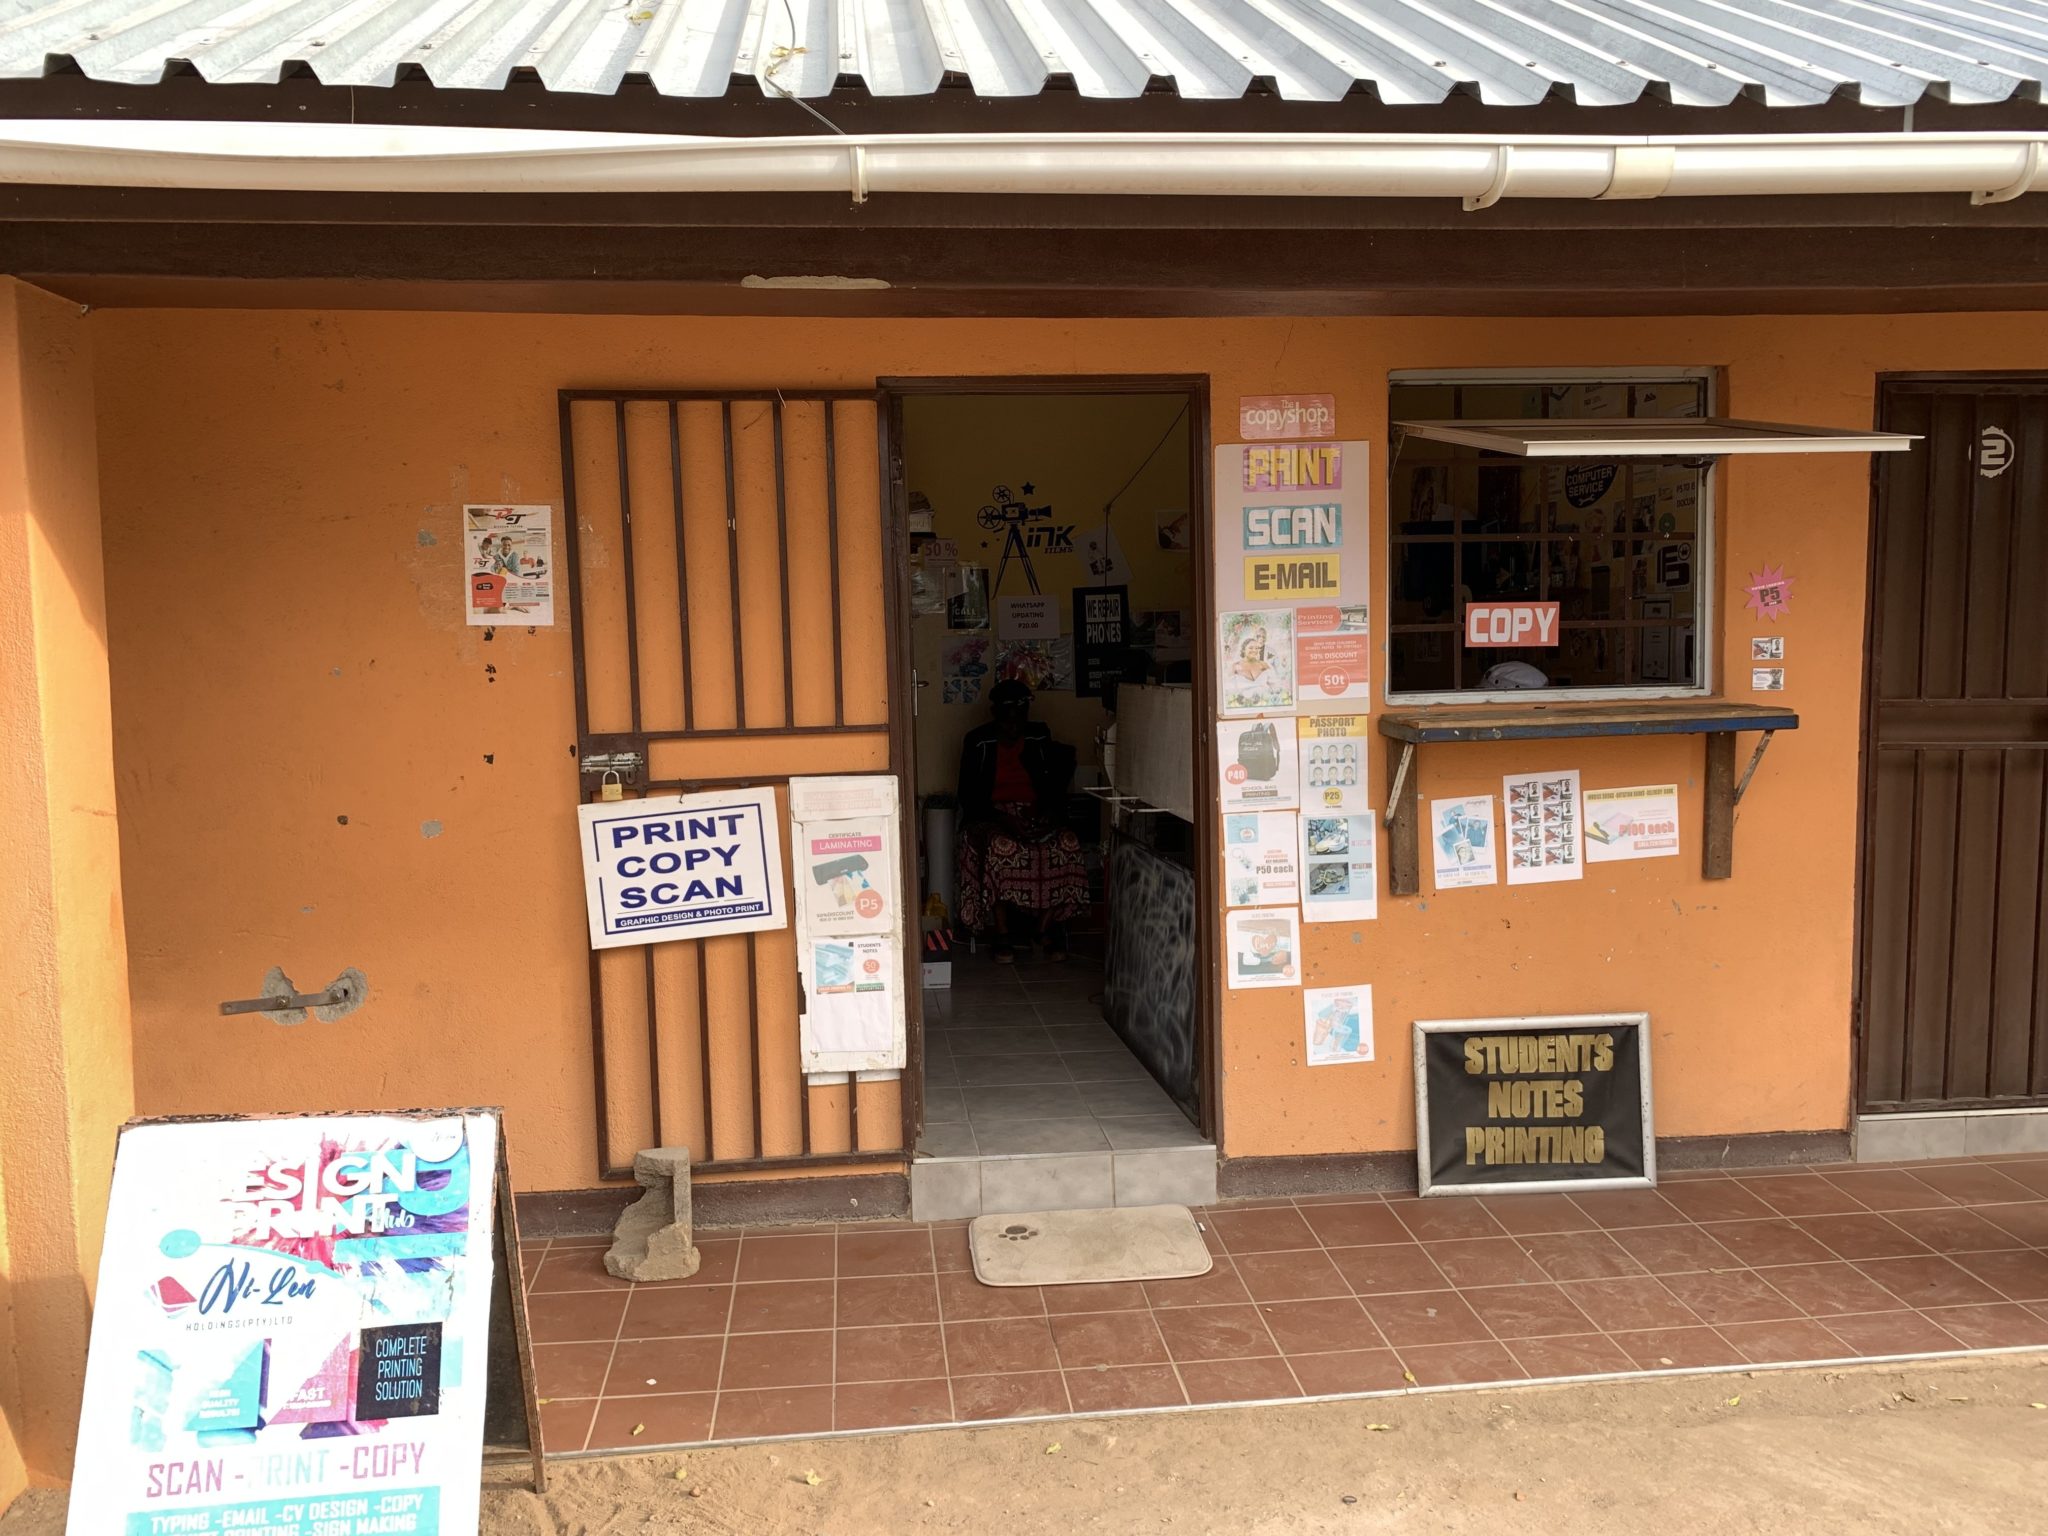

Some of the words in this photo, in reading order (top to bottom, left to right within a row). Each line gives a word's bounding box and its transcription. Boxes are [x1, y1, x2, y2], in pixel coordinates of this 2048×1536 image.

[1246, 402, 1328, 431] copyshop
[1981, 439, 2005, 465] 2
[1248, 447, 1341, 487] PRINT
[1566, 466, 1613, 485] COMPUTER
[1568, 481, 1604, 497] SERVICE
[1248, 508, 1336, 546] SCAN
[925, 542, 941, 557] 50
[1254, 562, 1337, 591] E-MAIL
[1759, 586, 1780, 603] P5
[1087, 599, 1097, 618] WE
[1098, 598, 1120, 618] REPAIR
[1086, 622, 1122, 645] PHONES
[1470, 608, 1557, 643] COPY
[1325, 651, 1358, 660] DISCOUNT
[1324, 674, 1345, 686] 50t
[1309, 717, 1356, 728] PASSPORT
[1317, 727, 1347, 737] PHOTO
[1227, 769, 1244, 780] P40
[1324, 791, 1340, 800] P25
[612, 814, 745, 848] PRINT
[1647, 821, 1675, 835] each
[819, 839, 873, 850] LAMINATING
[616, 844, 741, 878] COPY
[1256, 865, 1272, 874] P50
[1273, 864, 1294, 873] each
[620, 875, 744, 909] SCAN
[620, 914, 660, 927] GRAPHIC
[661, 911, 695, 922] DESIGN
[704, 906, 734, 917] PHOTO
[735, 903, 761, 913] PRINT
[860, 898, 879, 910] P5
[1464, 1033, 1614, 1074] STUDENTS
[1488, 1080, 1583, 1118] NOTES
[1465, 1126, 1605, 1165] PRINTING
[228, 1152, 416, 1202] ESIGN
[375, 1336, 427, 1358] COMPLETE
[377, 1358, 423, 1379] PRINTING
[375, 1379, 423, 1401] SOLUTION
[146, 1459, 223, 1498] SCAN
[151, 1512, 210, 1534] TYPING
[309, 1498, 369, 1520] DESIGN
[357, 1513, 417, 1534] MAKING
